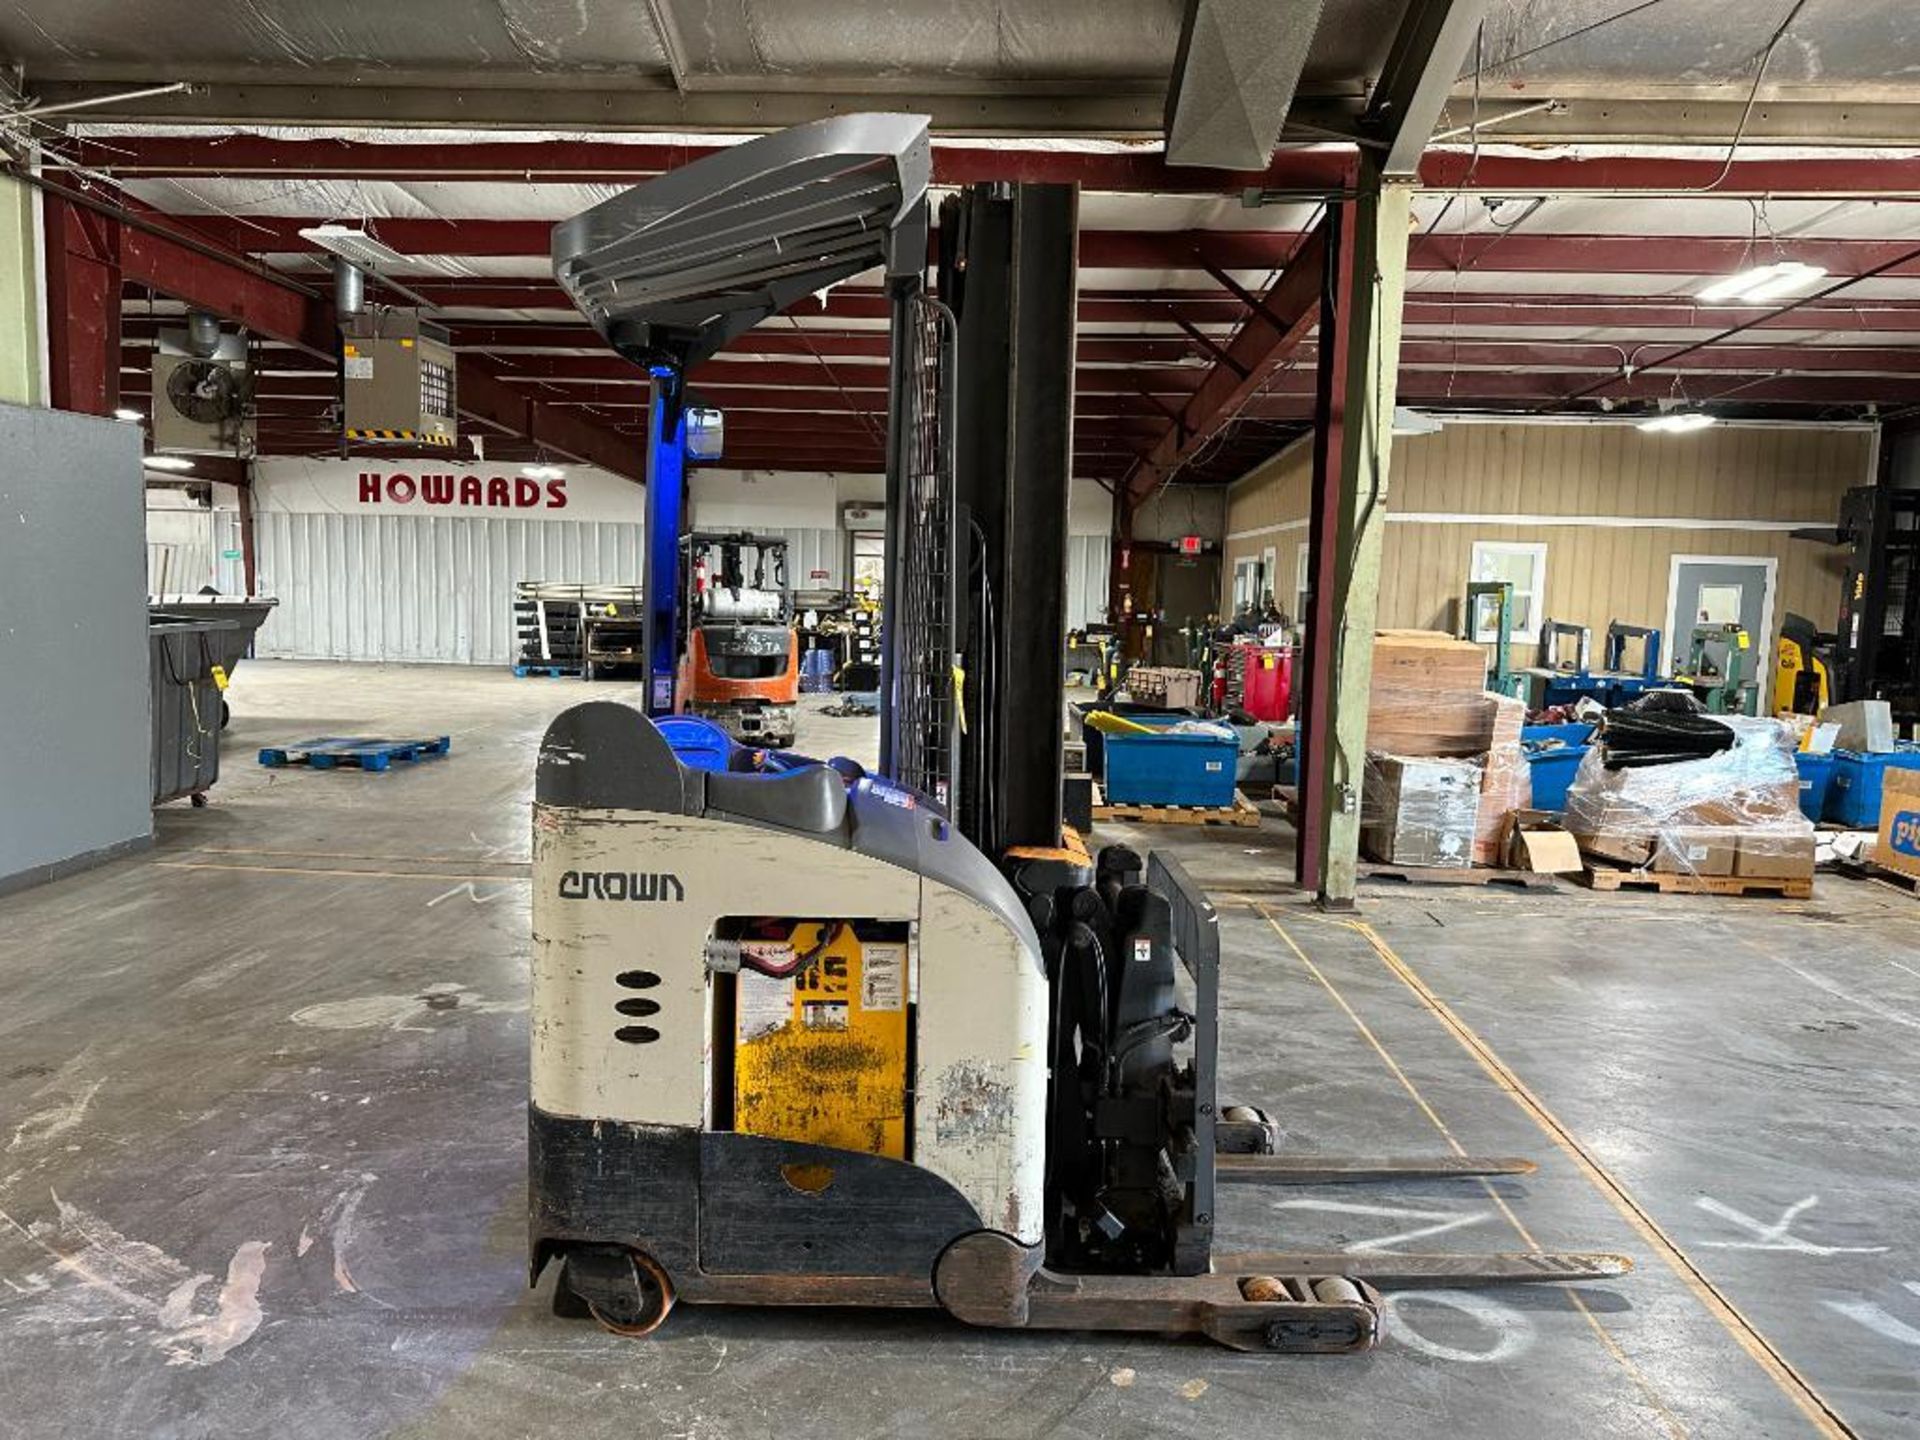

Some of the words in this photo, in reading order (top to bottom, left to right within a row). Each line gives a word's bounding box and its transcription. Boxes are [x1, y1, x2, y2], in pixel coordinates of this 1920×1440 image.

[359, 473, 568, 508] HOWARDS
[719, 641, 783, 655] TOYOTA
[558, 870, 684, 901] CROWN
